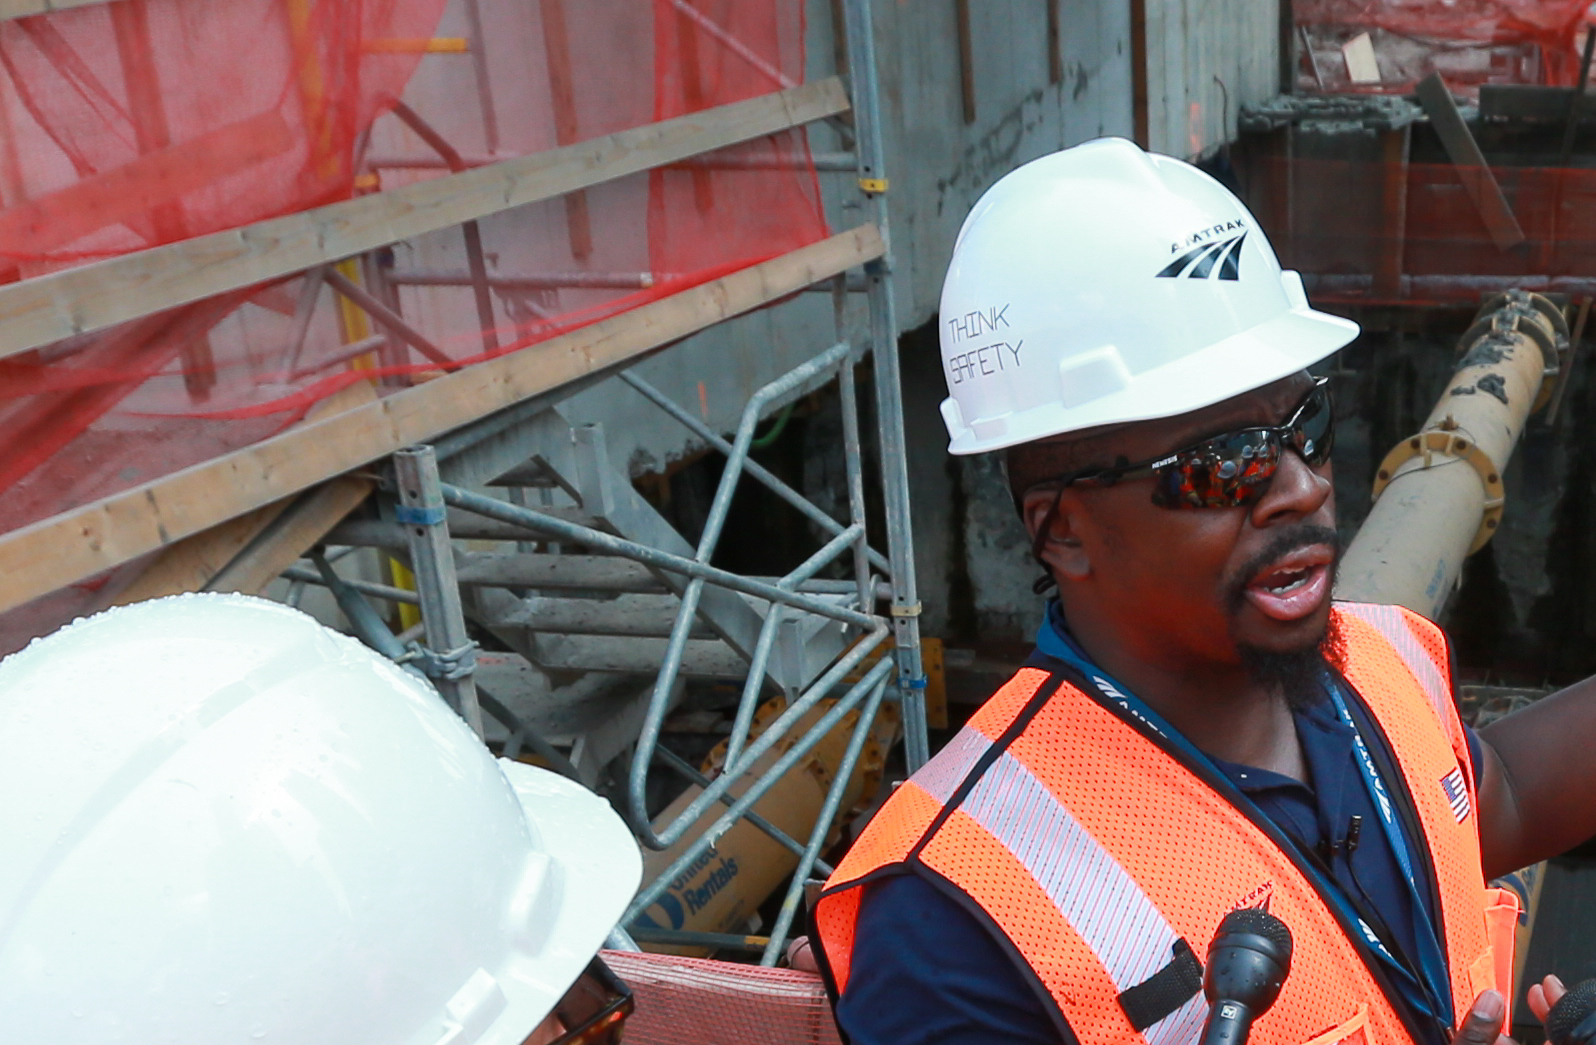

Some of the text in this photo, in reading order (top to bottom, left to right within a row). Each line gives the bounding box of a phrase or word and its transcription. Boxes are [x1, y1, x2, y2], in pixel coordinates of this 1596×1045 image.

[1171, 218, 1245, 254] AMTRAK
[948, 303, 1010, 343] THINK
[949, 339, 1023, 384] SAFETY
[682, 856, 739, 915] Rentals
[1223, 879, 1273, 914] MTRAK
